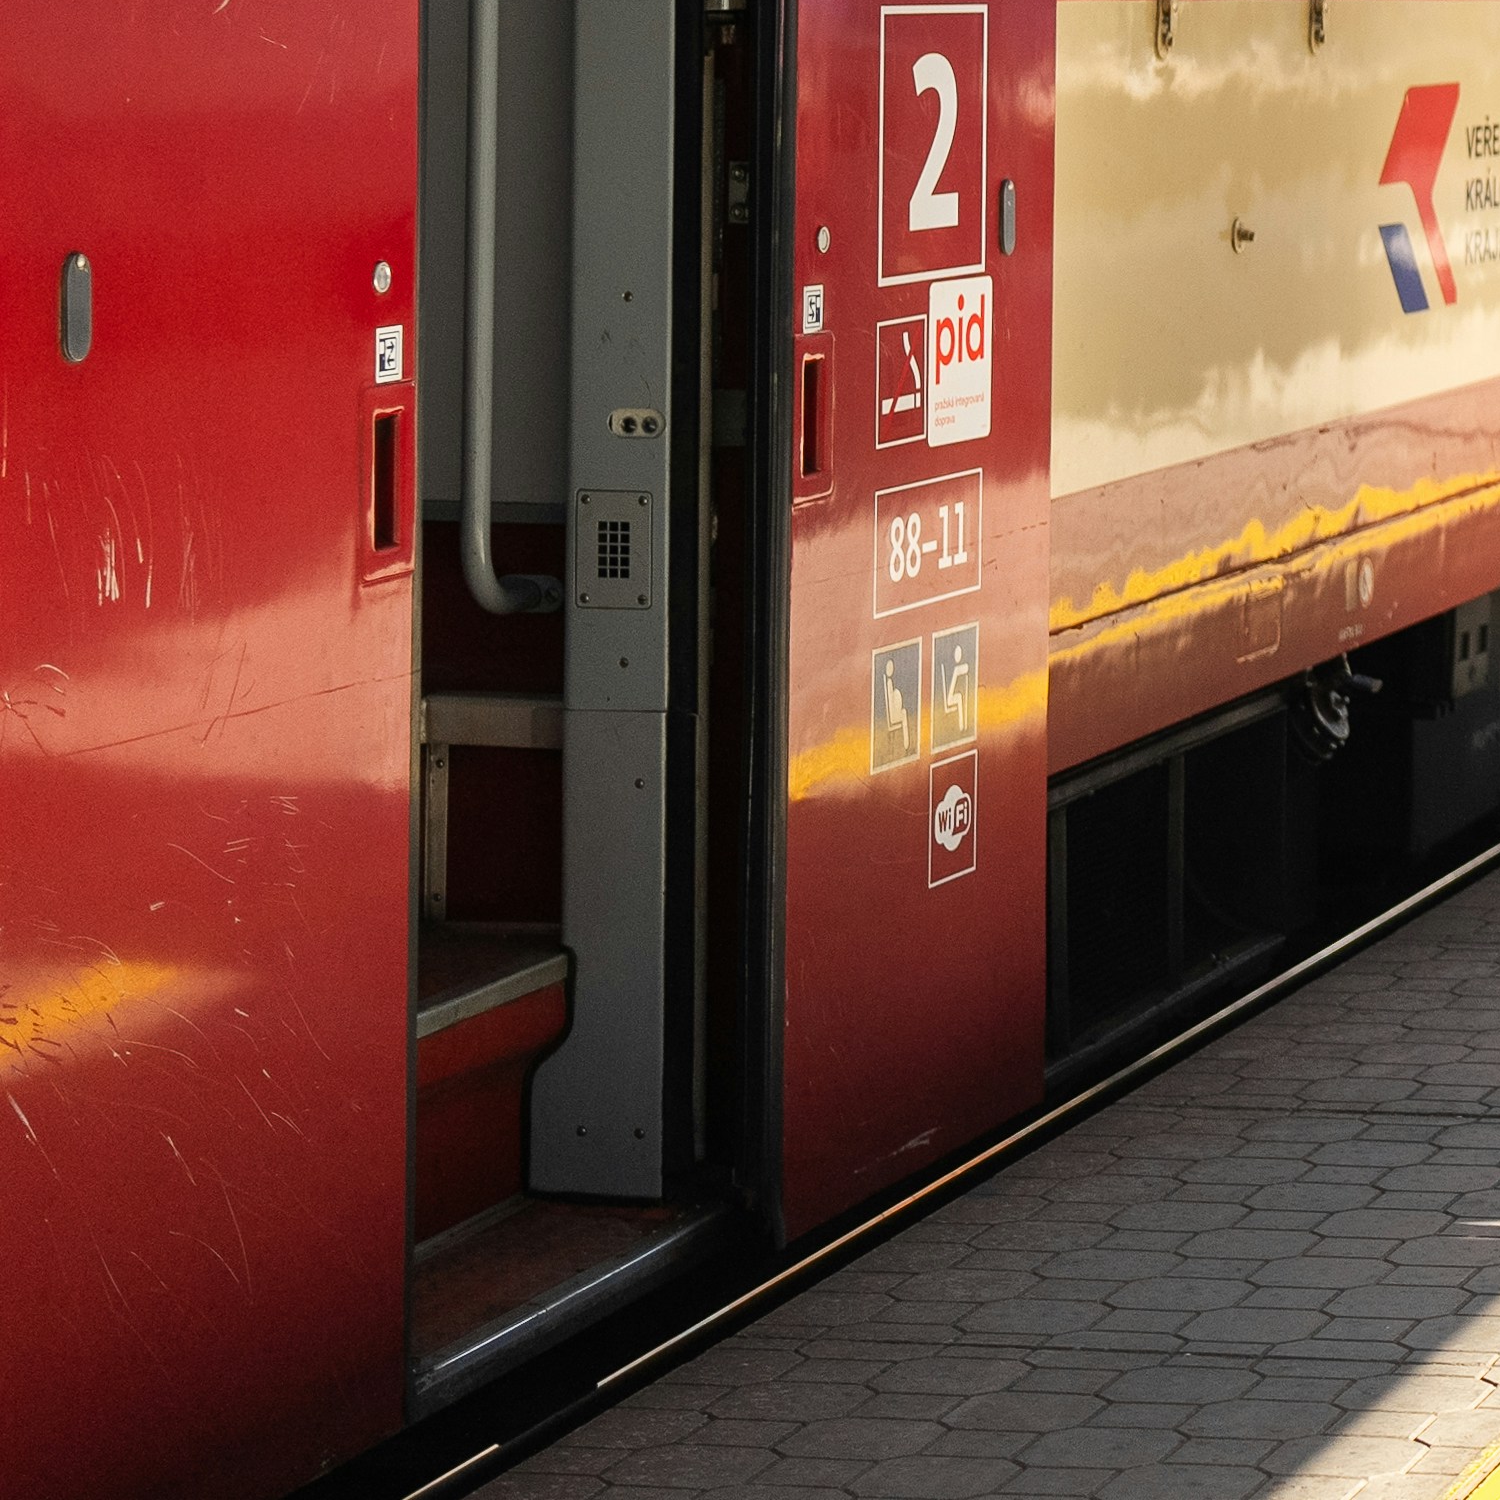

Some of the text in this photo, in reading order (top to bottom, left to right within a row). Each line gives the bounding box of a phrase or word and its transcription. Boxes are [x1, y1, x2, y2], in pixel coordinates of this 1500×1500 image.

[908, 51, 959, 232] 2
[934, 293, 985, 385] pid
[889, 501, 968, 583] 88-11
